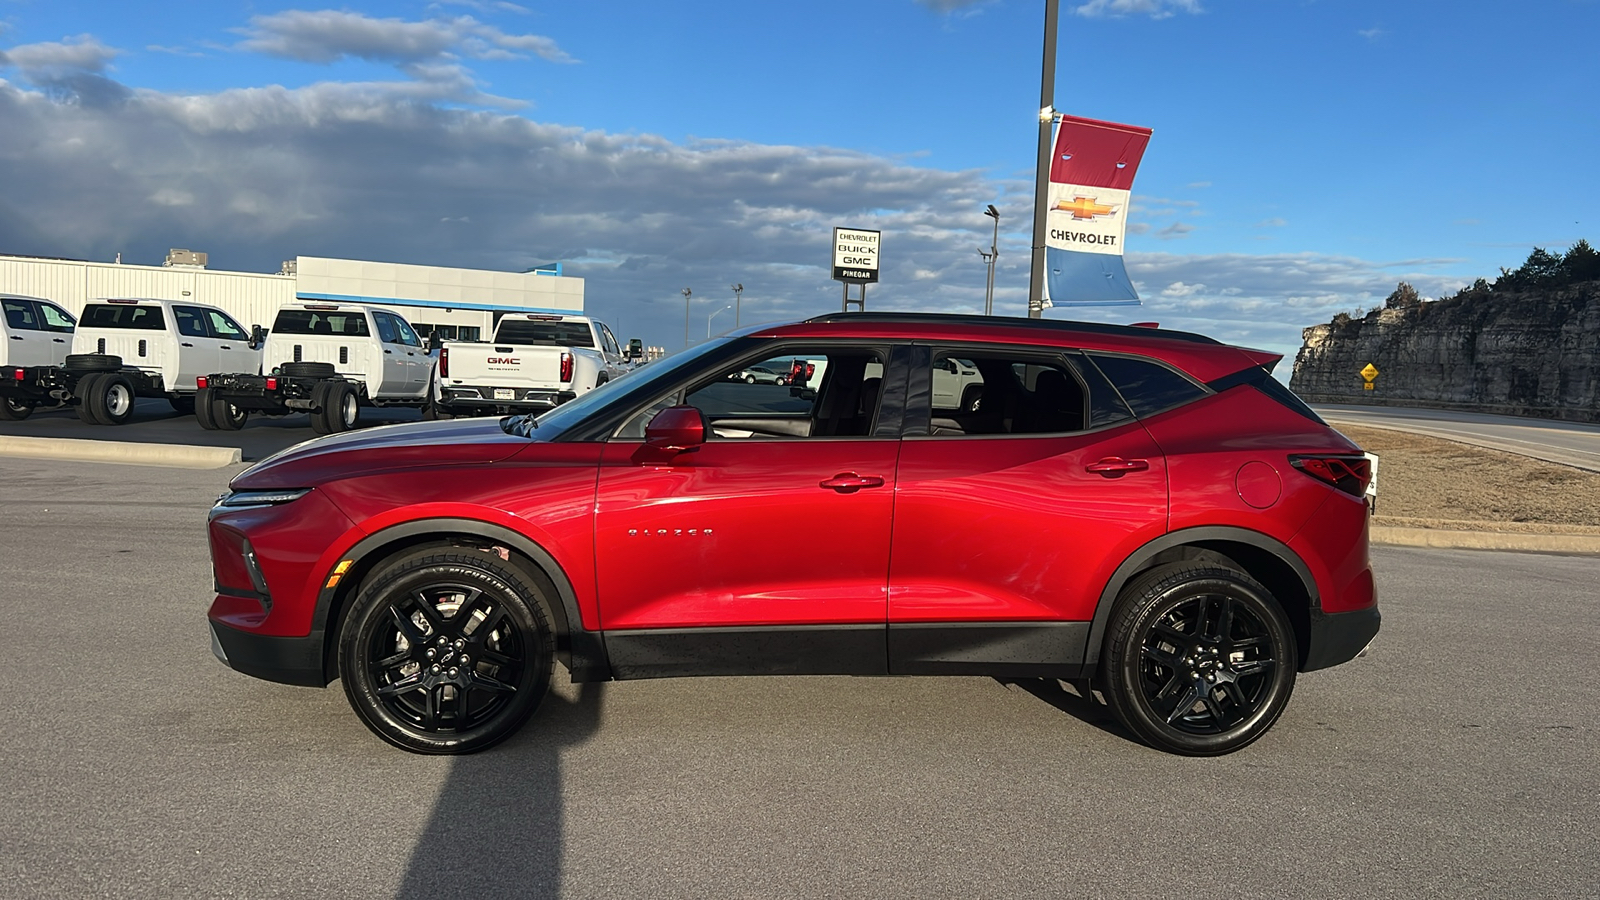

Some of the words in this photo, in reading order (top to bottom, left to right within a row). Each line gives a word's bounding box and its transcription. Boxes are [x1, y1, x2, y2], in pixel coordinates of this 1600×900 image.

[839, 233, 877, 243] CHEVROLET
[1050, 229, 1117, 246] CHEVROLET
[838, 244, 876, 255] BUICK
[843, 256, 871, 266] GMC
[842, 269, 871, 279] PINEGAR
[487, 357, 521, 365] GMC
[628, 528, 713, 536] BLAZER
